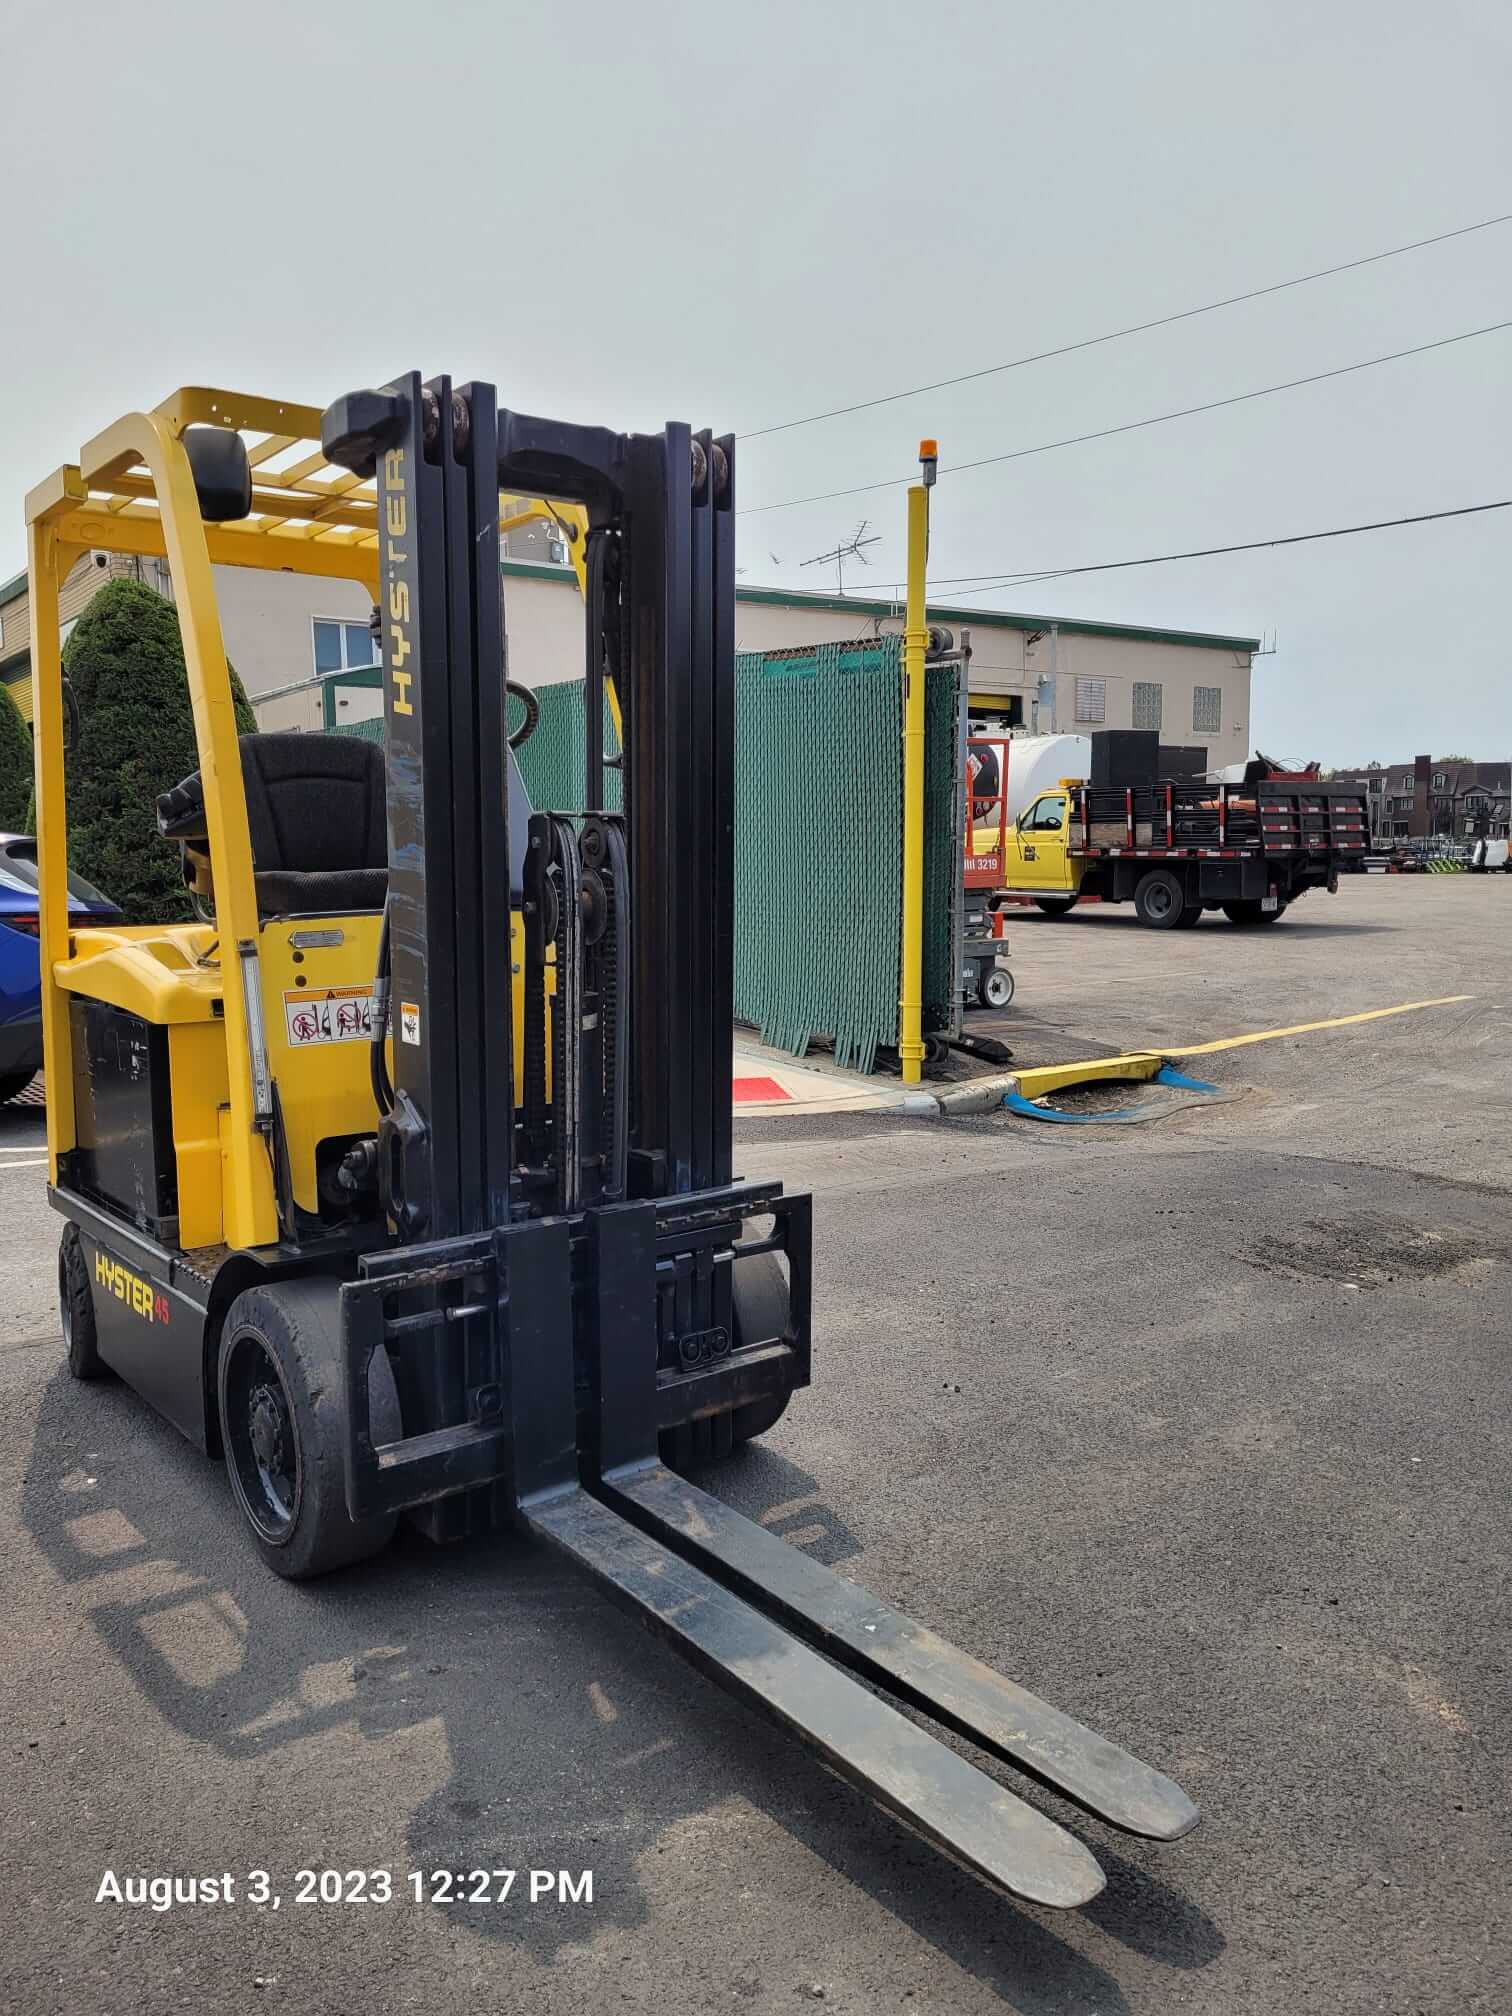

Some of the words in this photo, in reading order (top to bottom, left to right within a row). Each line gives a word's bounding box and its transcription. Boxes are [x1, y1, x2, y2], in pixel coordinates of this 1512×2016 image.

[384, 448, 413, 716] HYSTER
[977, 858, 998, 870] 3219
[95, 1250, 154, 1323] HYSTER
